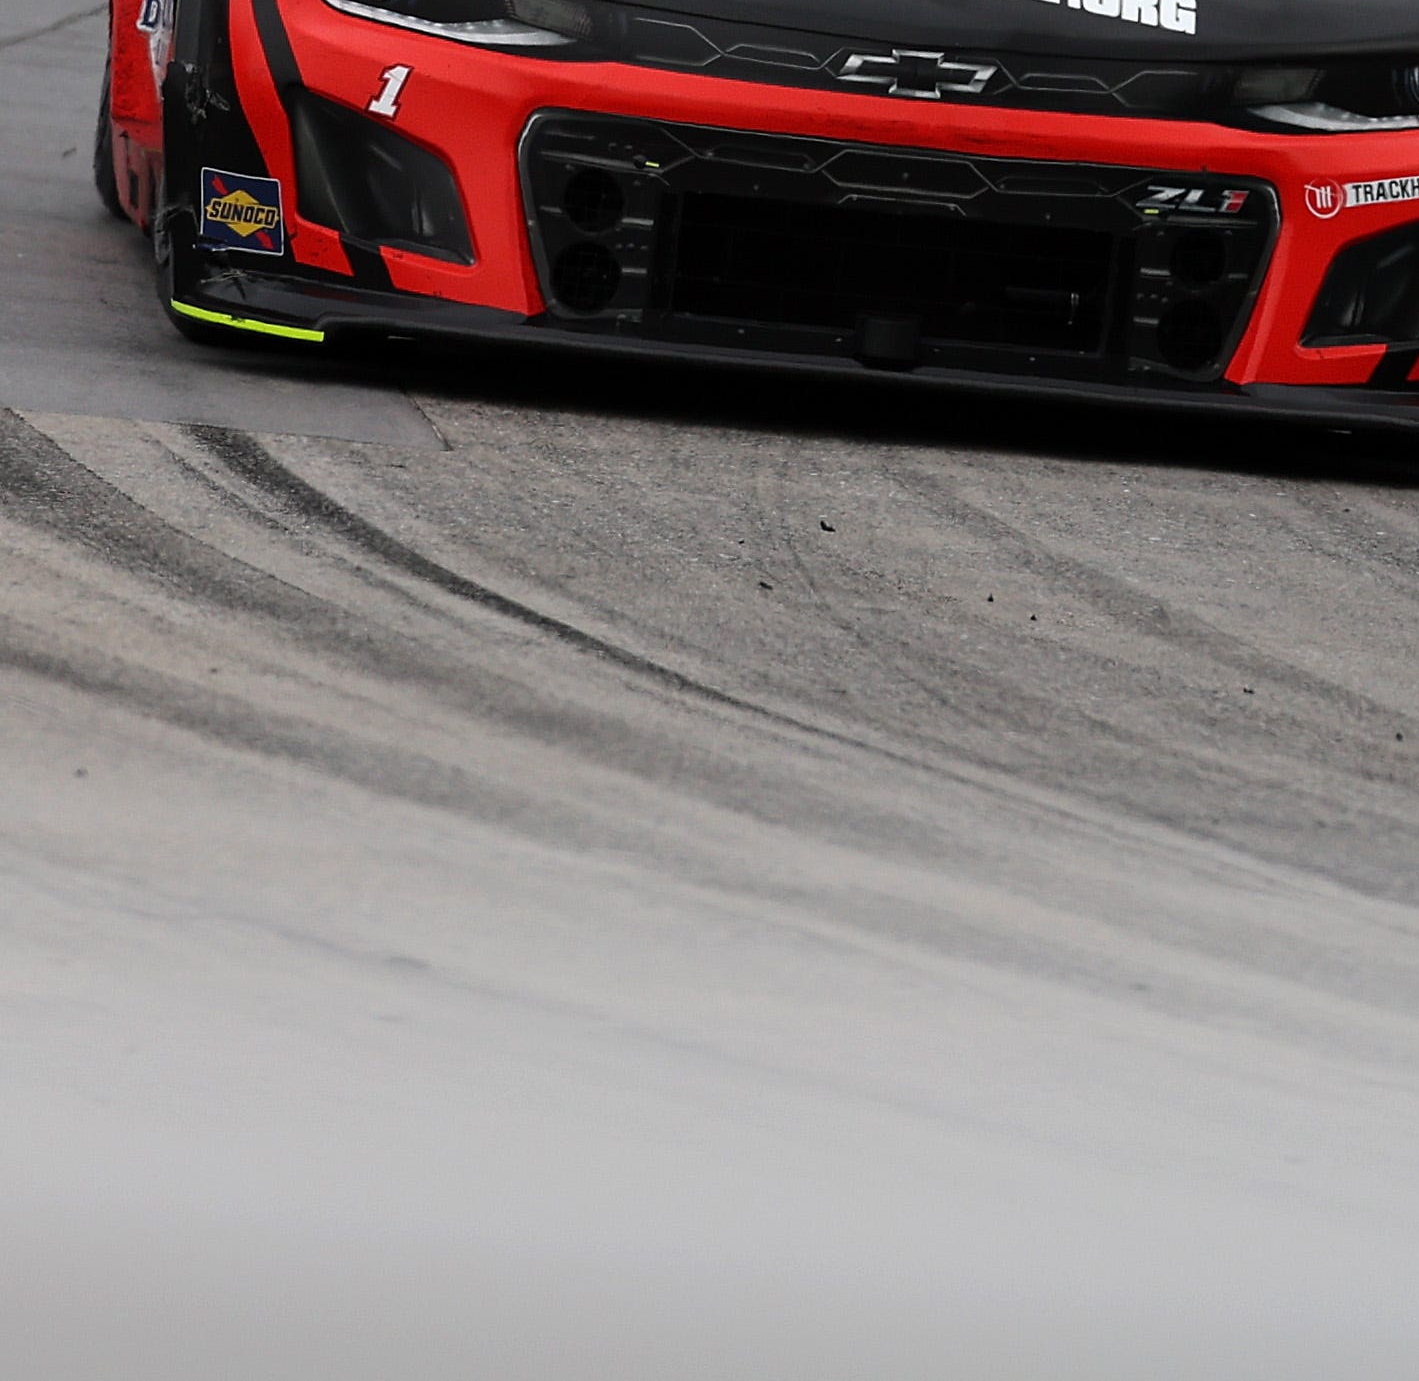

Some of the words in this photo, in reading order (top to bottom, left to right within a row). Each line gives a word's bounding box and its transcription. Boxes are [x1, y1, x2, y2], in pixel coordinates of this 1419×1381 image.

[368, 65, 412, 119] 1
[206, 197, 279, 228] SUNOCO
[1136, 185, 1250, 213] ZL1
